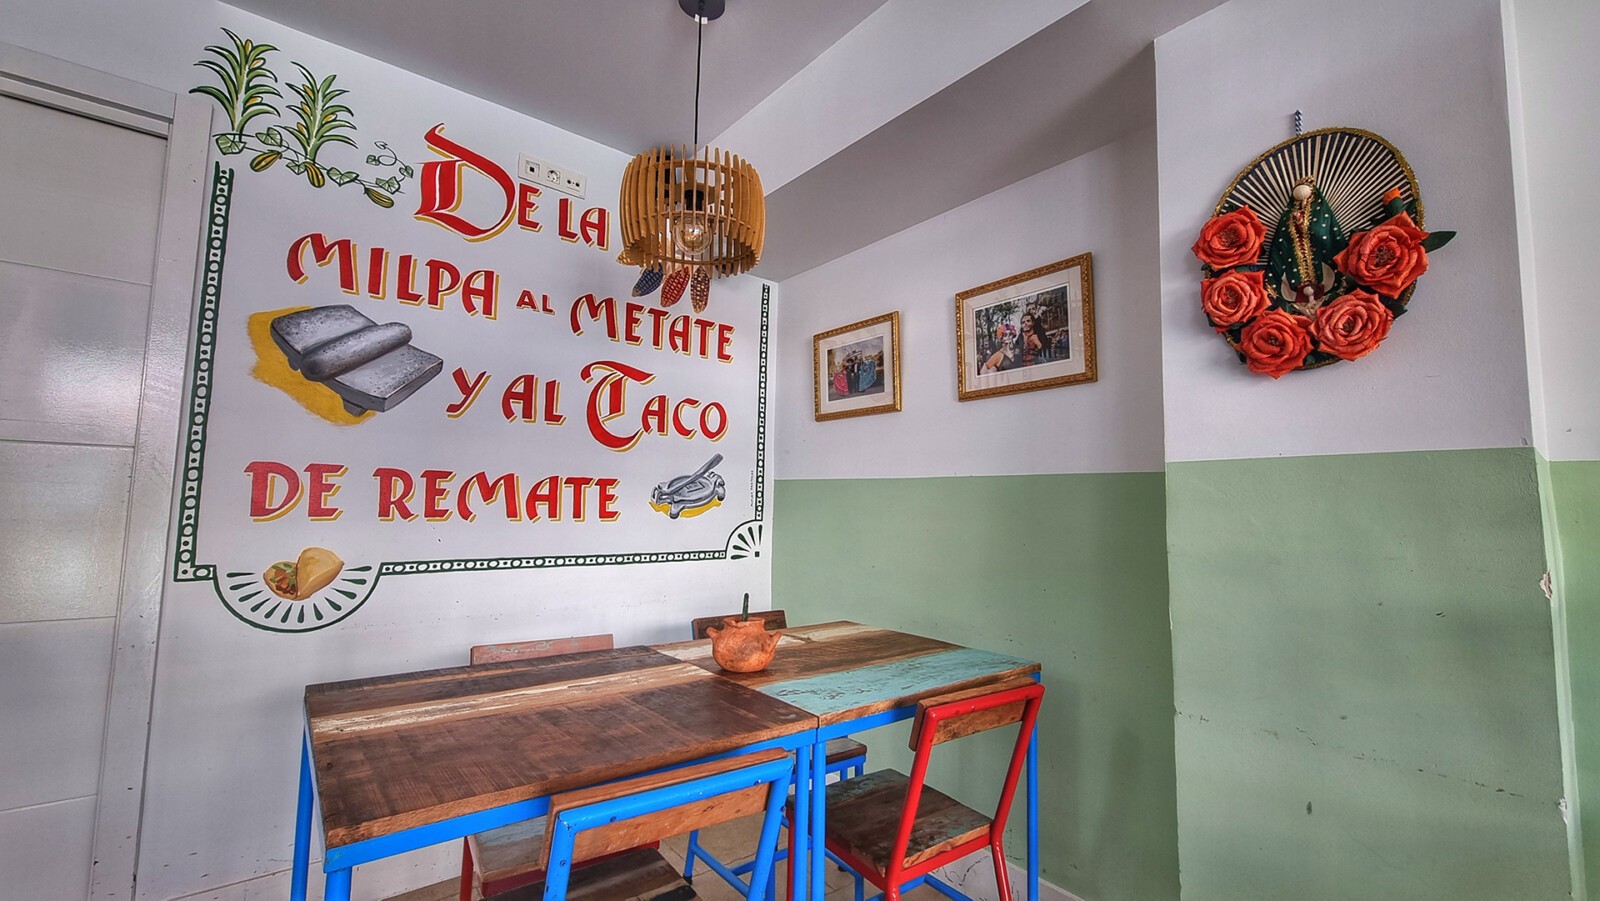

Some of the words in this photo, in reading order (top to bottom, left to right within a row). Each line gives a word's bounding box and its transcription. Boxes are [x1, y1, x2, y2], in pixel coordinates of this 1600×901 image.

[415, 123, 542, 243] DE
[558, 198, 610, 250] LA
[287, 233, 499, 320] MILPA
[515, 289, 556, 315] AL
[570, 293, 735, 363] METATE
[446, 367, 491, 419] Y
[502, 374, 566, 425] AL
[581, 361, 729, 453] TACO
[244, 461, 348, 522] DE
[373, 468, 621, 523] REMATE
